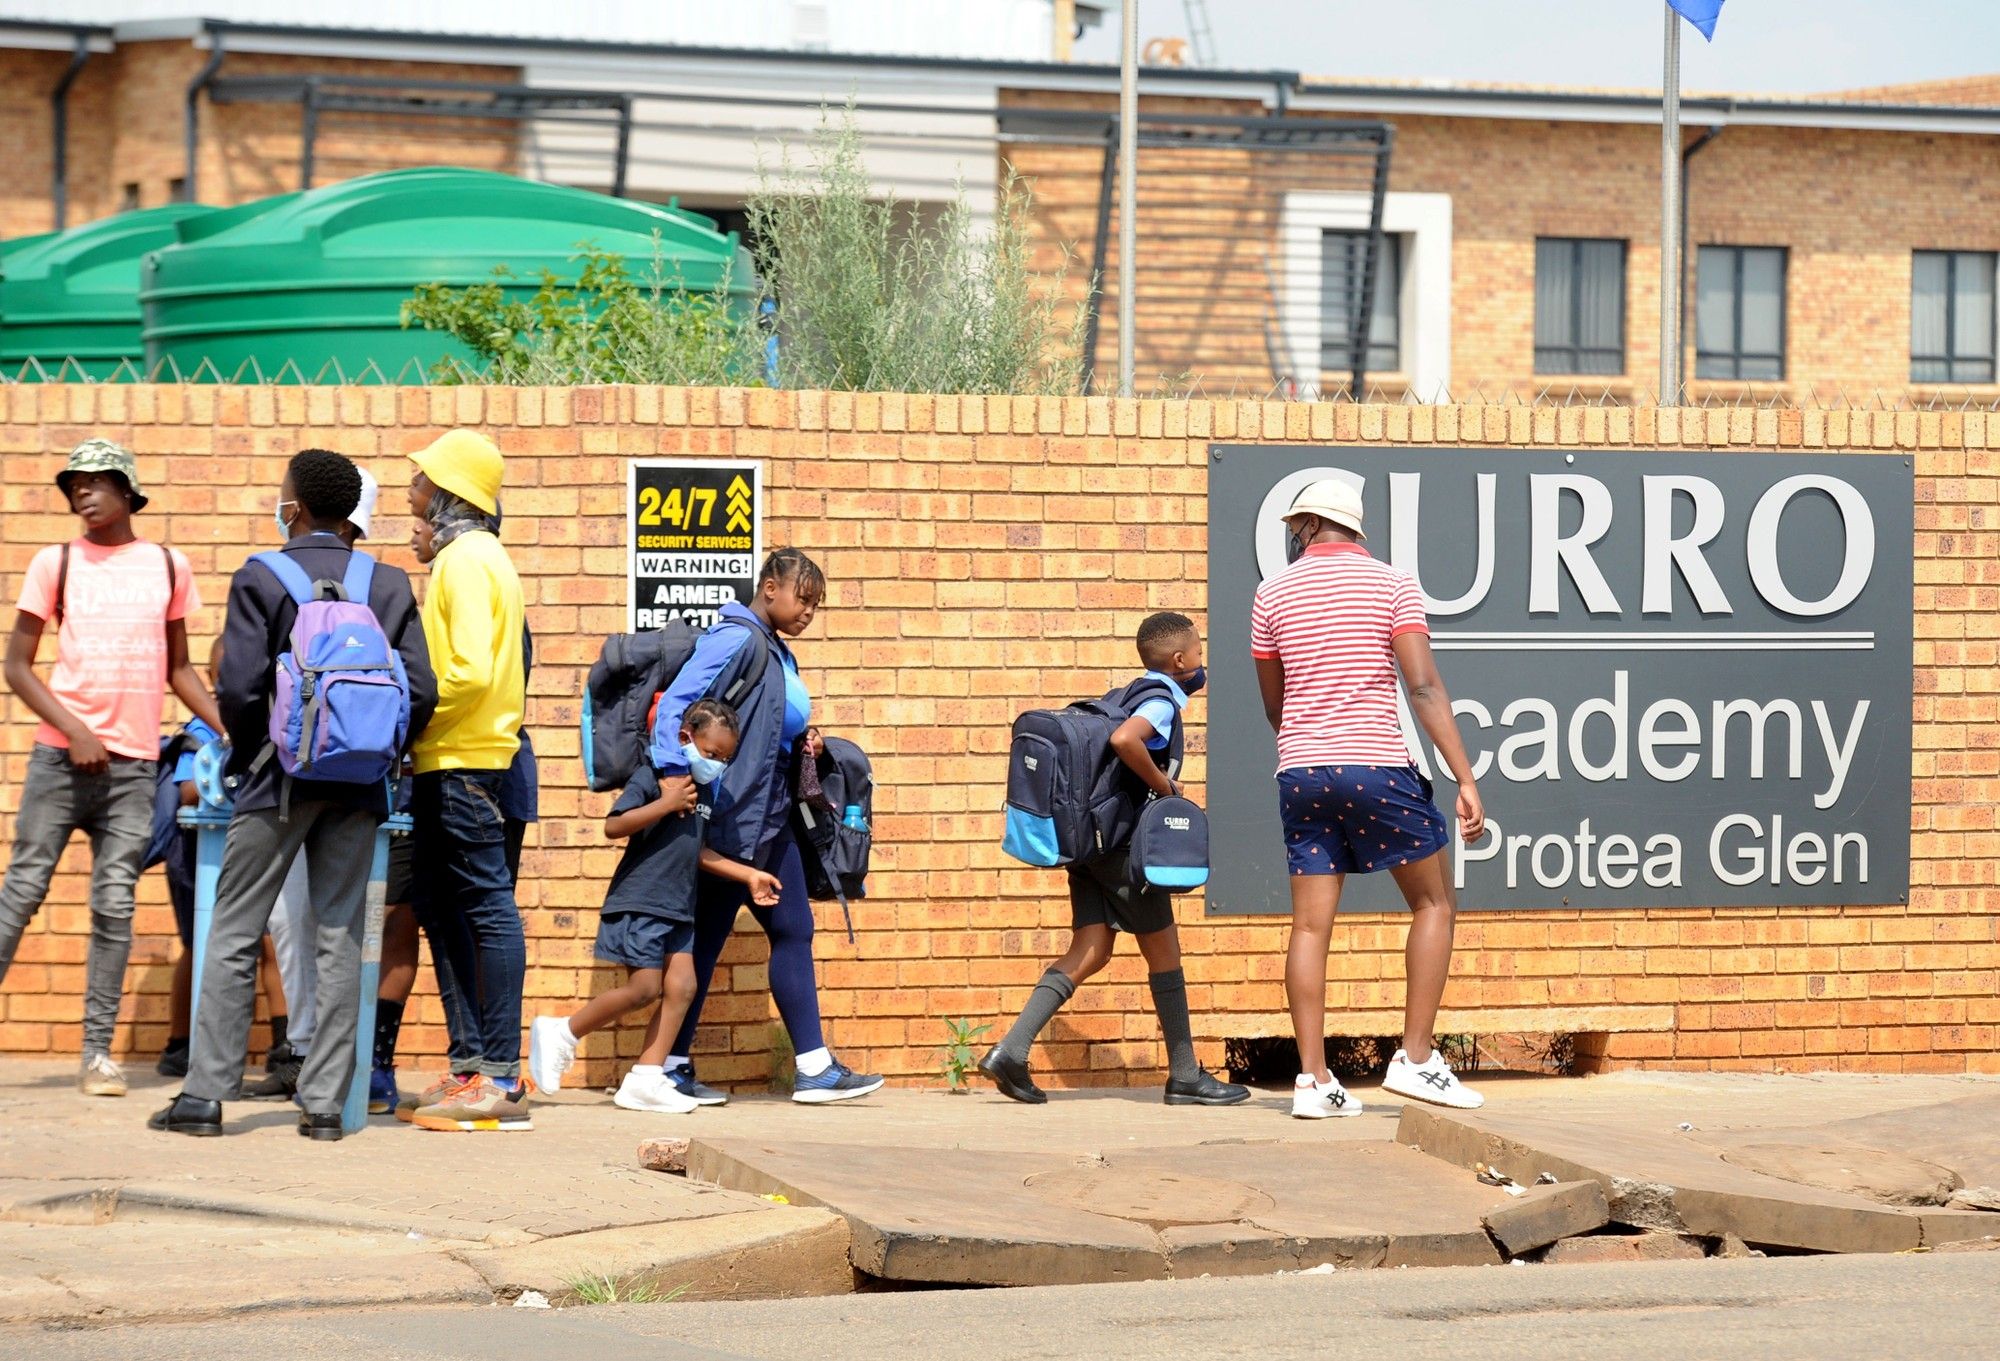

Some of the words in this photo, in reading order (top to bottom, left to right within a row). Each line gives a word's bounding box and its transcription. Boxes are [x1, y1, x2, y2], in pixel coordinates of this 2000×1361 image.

[638, 486, 718, 531] 24/7
[637, 535, 694, 548] SECURITY
[696, 536, 752, 549] SERVICES
[1255, 466, 1876, 616] CURRO
[641, 558, 749, 574] WARNING!
[653, 584, 736, 605] ARMED
[637, 608, 725, 629] REACTI
[1164, 816, 1190, 826] CURRO
[1454, 817, 1683, 889] Protea
[1709, 813, 1869, 887] Glen
